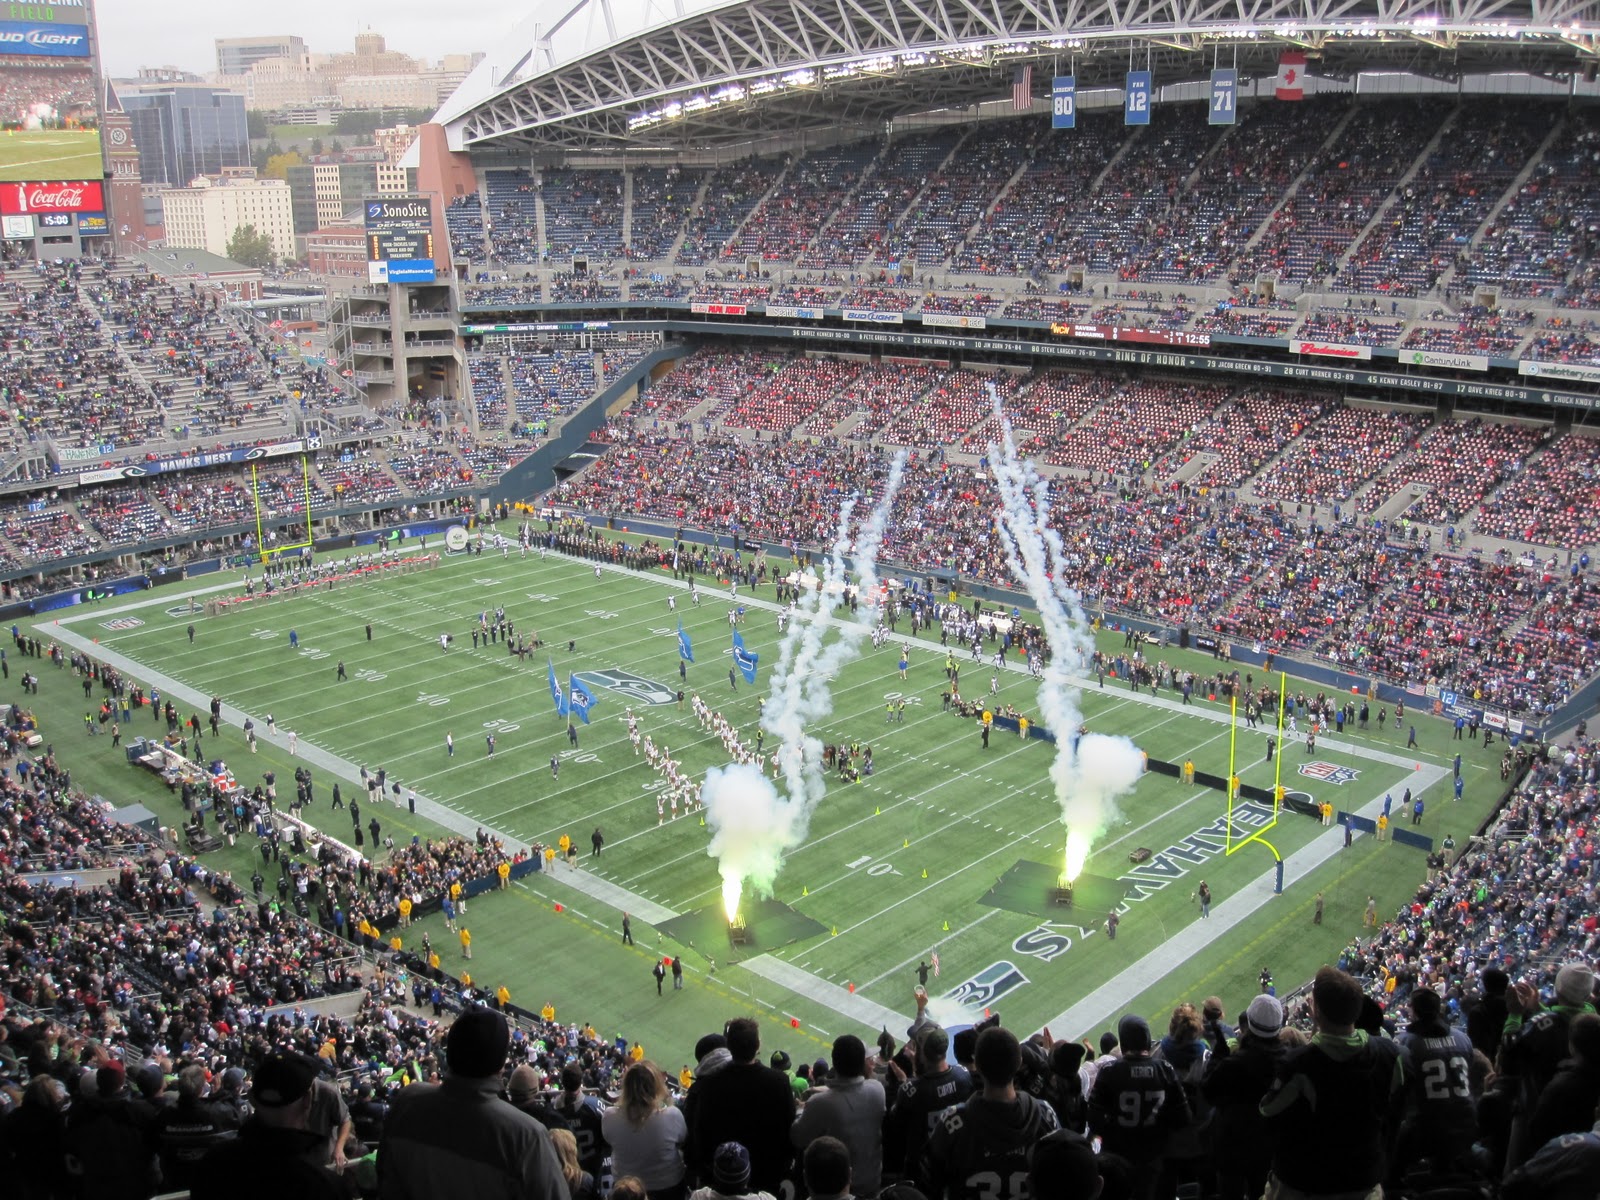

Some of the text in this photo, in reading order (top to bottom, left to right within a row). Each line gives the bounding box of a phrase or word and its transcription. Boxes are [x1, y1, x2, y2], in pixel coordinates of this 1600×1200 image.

[10, 5, 54, 20] FIELD
[0, 32, 83, 44] UD LIGHT
[1055, 96, 1072, 115] 80
[1129, 92, 1146, 111] 12
[1214, 91, 1232, 110] 71
[30, 188, 83, 208] Coca-Cola
[383, 203, 428, 217] SonoSite
[44, 215, 68, 225] 15:00
[774, 308, 814, 318] SeattleBank
[1185, 334, 1210, 344] 12:55
[1300, 342, 1359, 357] Budweiser
[1115, 351, 1186, 366] RING OF HONOR
[1424, 355, 1471, 367] CenturyLink
[1311, 369, 1331, 378] WARNER
[1380, 377, 1398, 385] KENNY
[1400, 379, 1420, 388] EASLEY
[1457, 384, 1527, 399] 17 DAVE KRIEG 80-91
[1554, 395, 1573, 404] CHUCK
[1575, 397, 1593, 406] KNOX
[160, 452, 232, 471] HAWKS NEST
[1442, 692, 1452, 704] 12
[845, 855, 893, 876] 10
[1422, 1057, 1470, 1099] 23
[902, 1082, 917, 1097] 59
[1118, 1090, 1166, 1128] 97
[578, 1129, 595, 1160] 2
